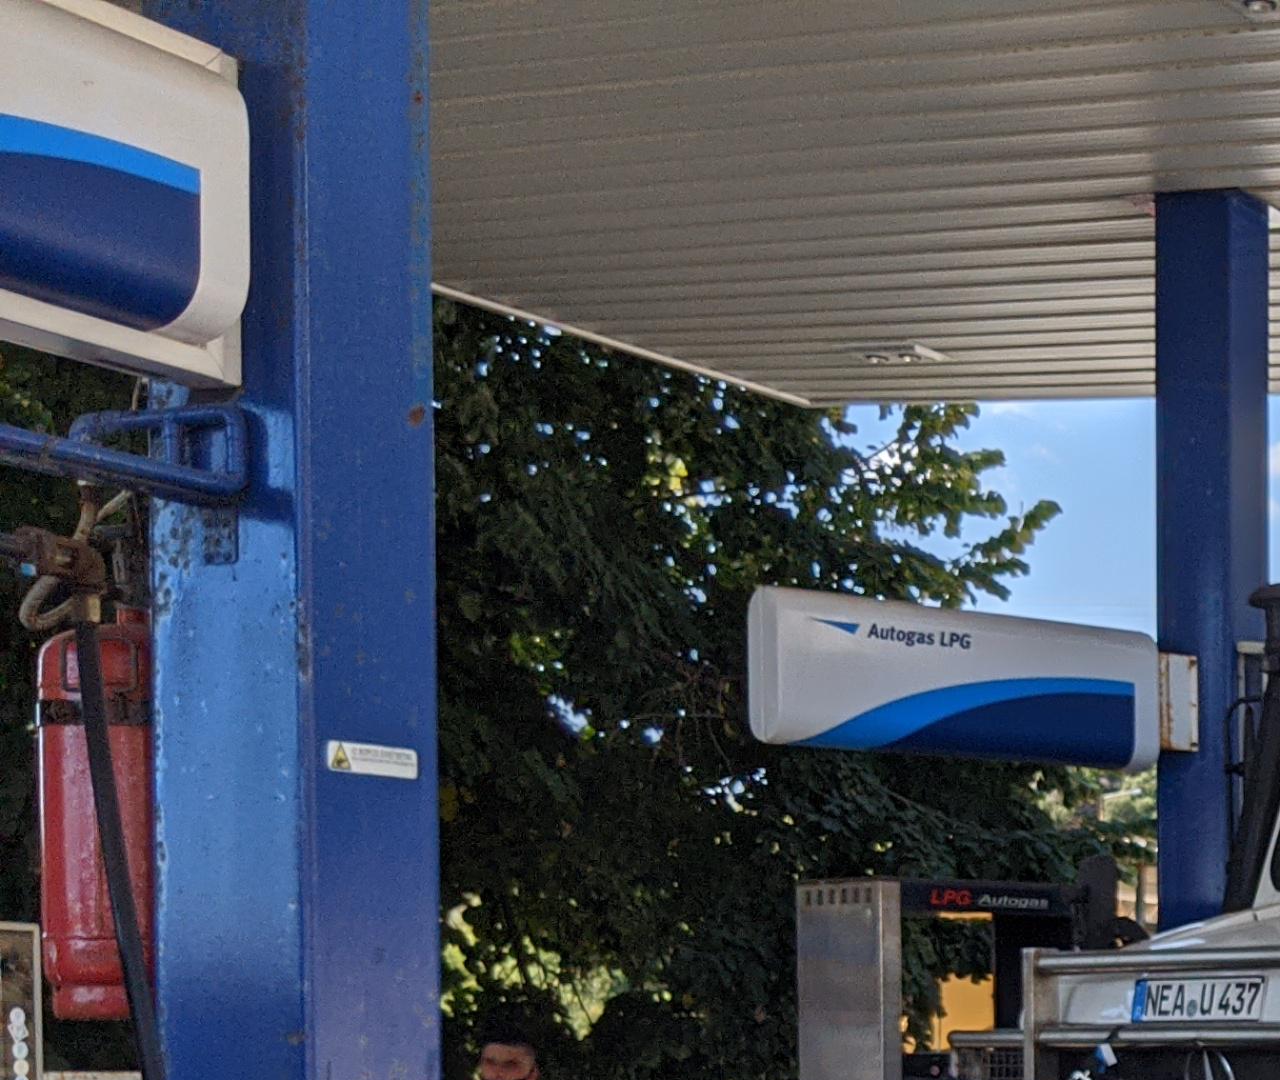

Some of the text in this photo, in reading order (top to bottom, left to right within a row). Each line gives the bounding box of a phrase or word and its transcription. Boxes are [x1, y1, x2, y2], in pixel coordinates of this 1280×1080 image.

[867, 623, 972, 650] Autogas LPG
[930, 888, 1049, 910] LPG Autogas
[1145, 983, 1186, 1017] NEA
[1217, 981, 1261, 1016] 437
